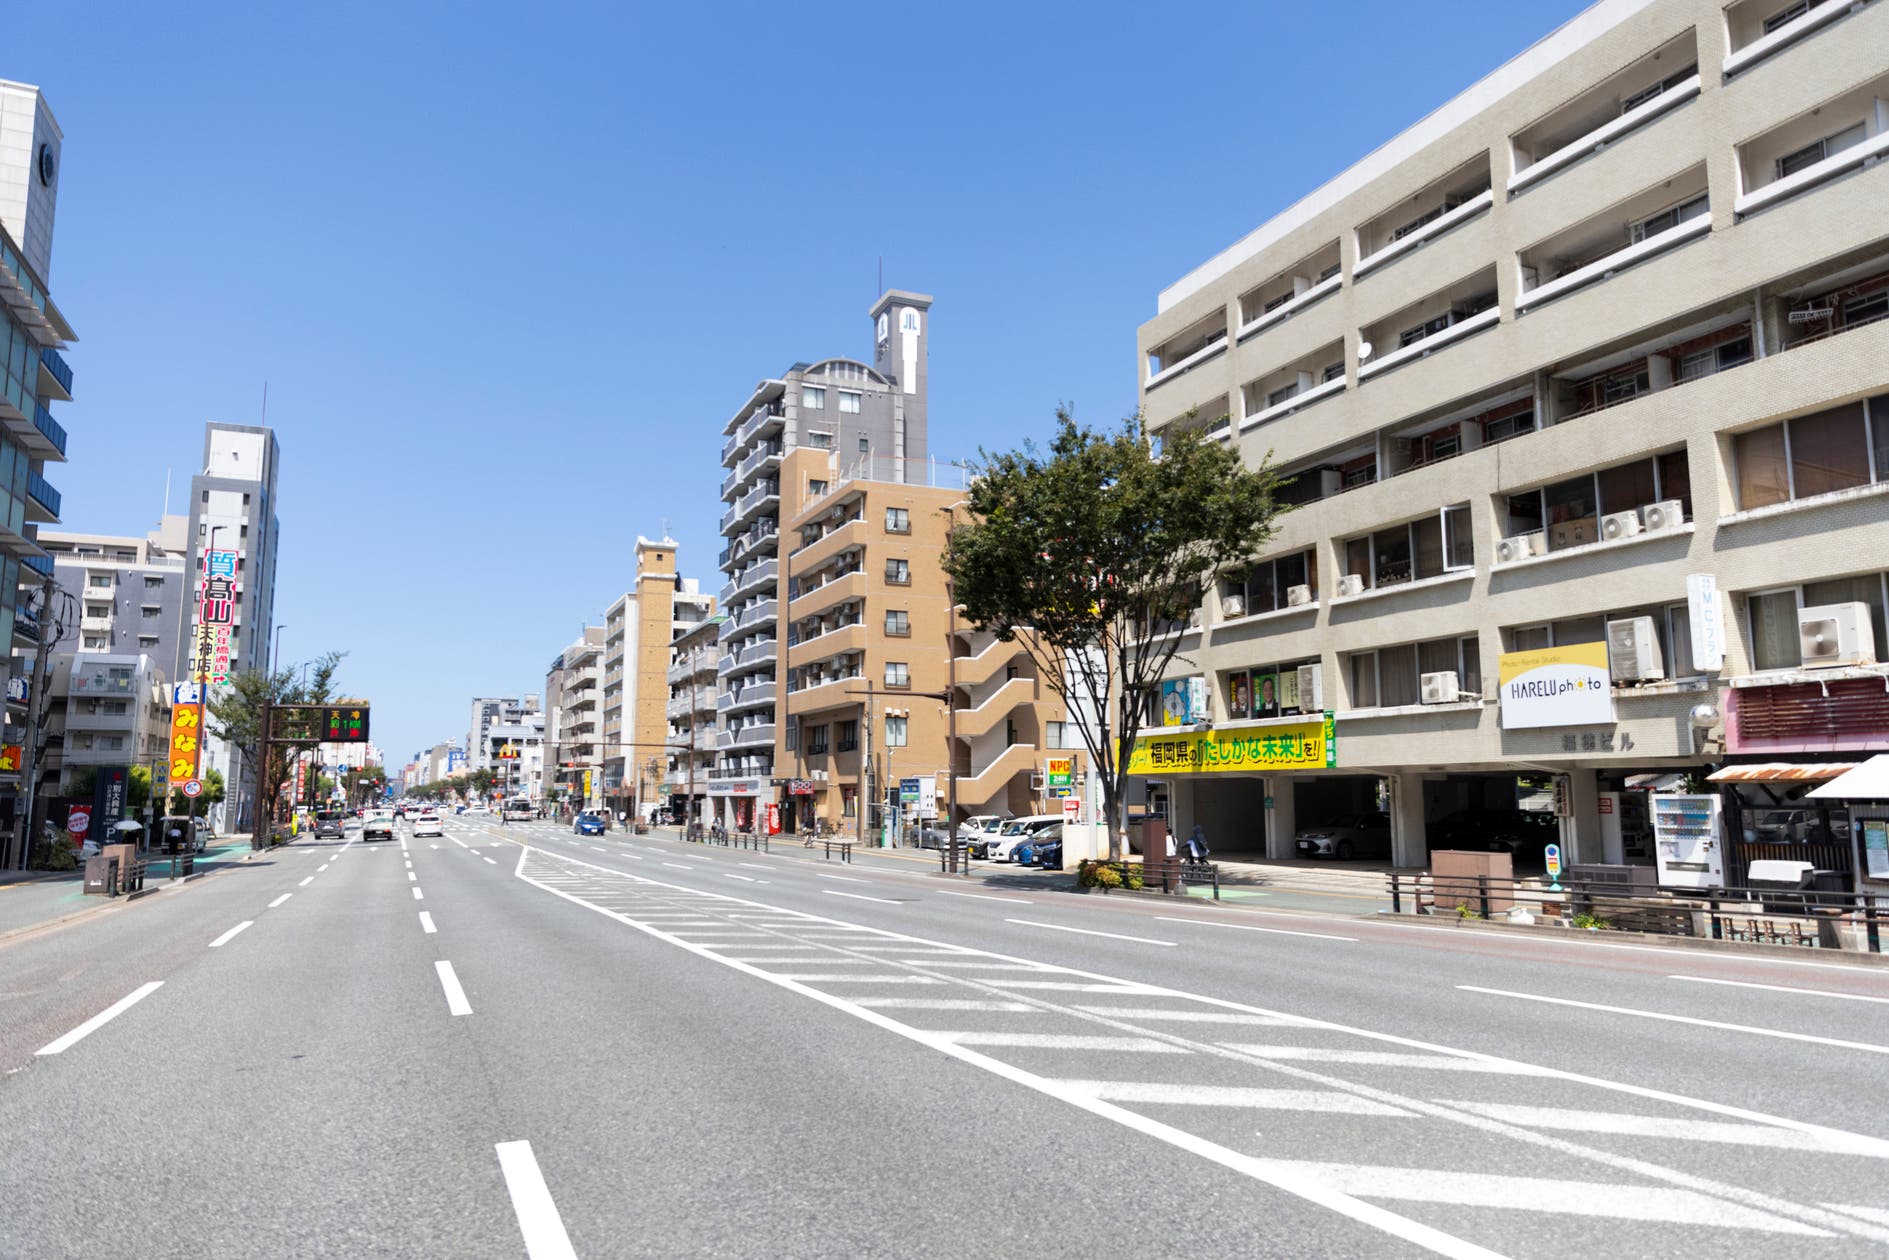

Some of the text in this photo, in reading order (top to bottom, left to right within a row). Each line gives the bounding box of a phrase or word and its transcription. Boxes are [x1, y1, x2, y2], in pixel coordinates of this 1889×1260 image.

[197, 626, 214, 672] 天神店
[1511, 679, 1557, 700] HARELU
[171, 708, 199, 778] みなみ
[1049, 760, 1071, 772] NPC
